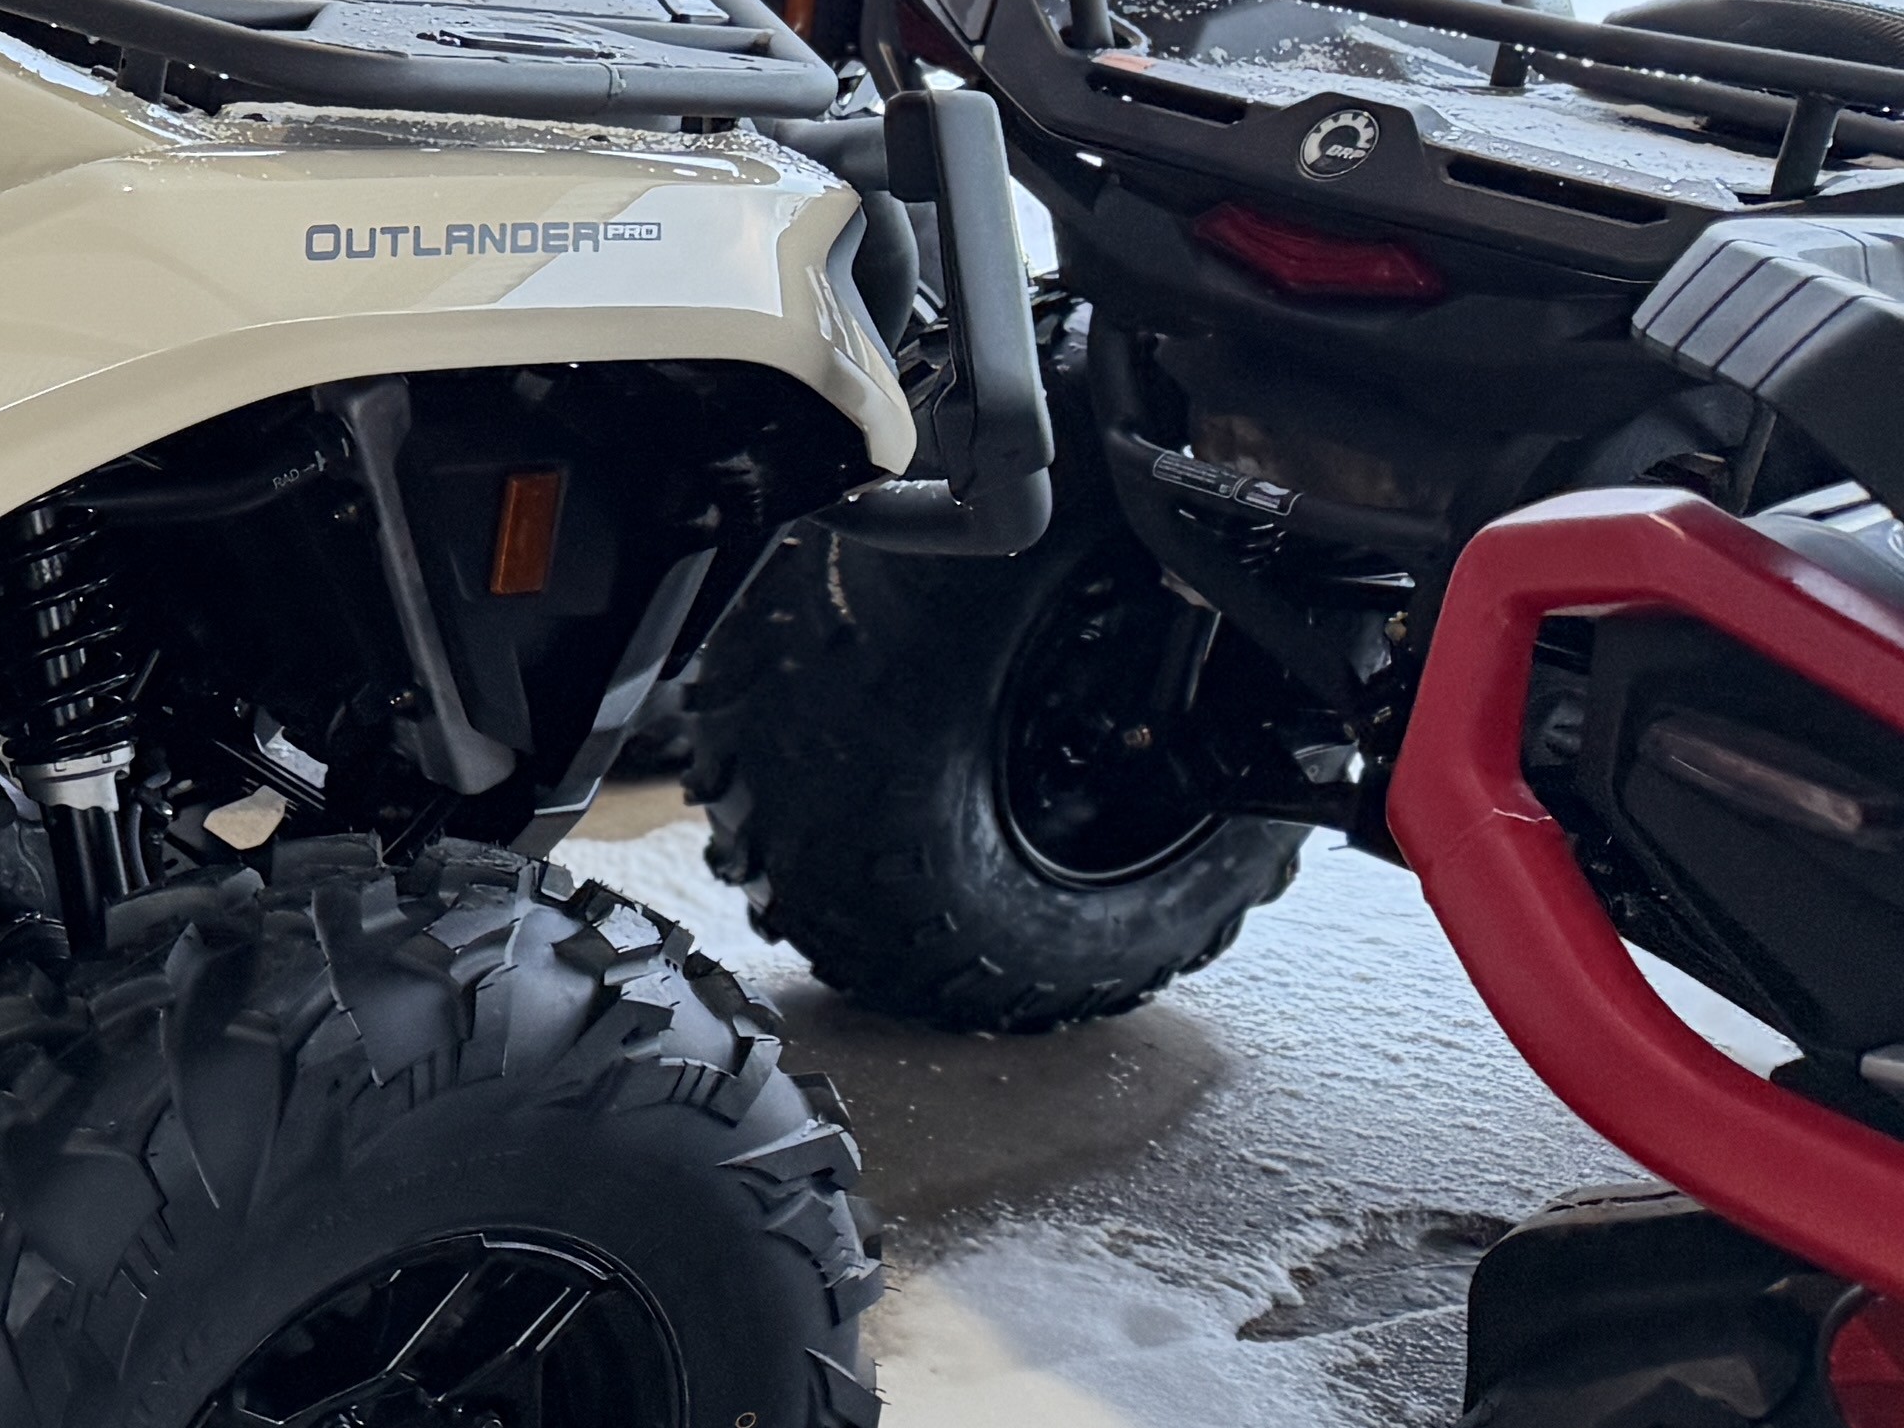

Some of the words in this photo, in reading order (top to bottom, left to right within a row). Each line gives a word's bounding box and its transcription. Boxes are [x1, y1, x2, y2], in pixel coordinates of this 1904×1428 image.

[304, 221, 601, 262] OUTLANDER
[604, 223, 661, 241] PRO
[272, 468, 300, 489] RAD
